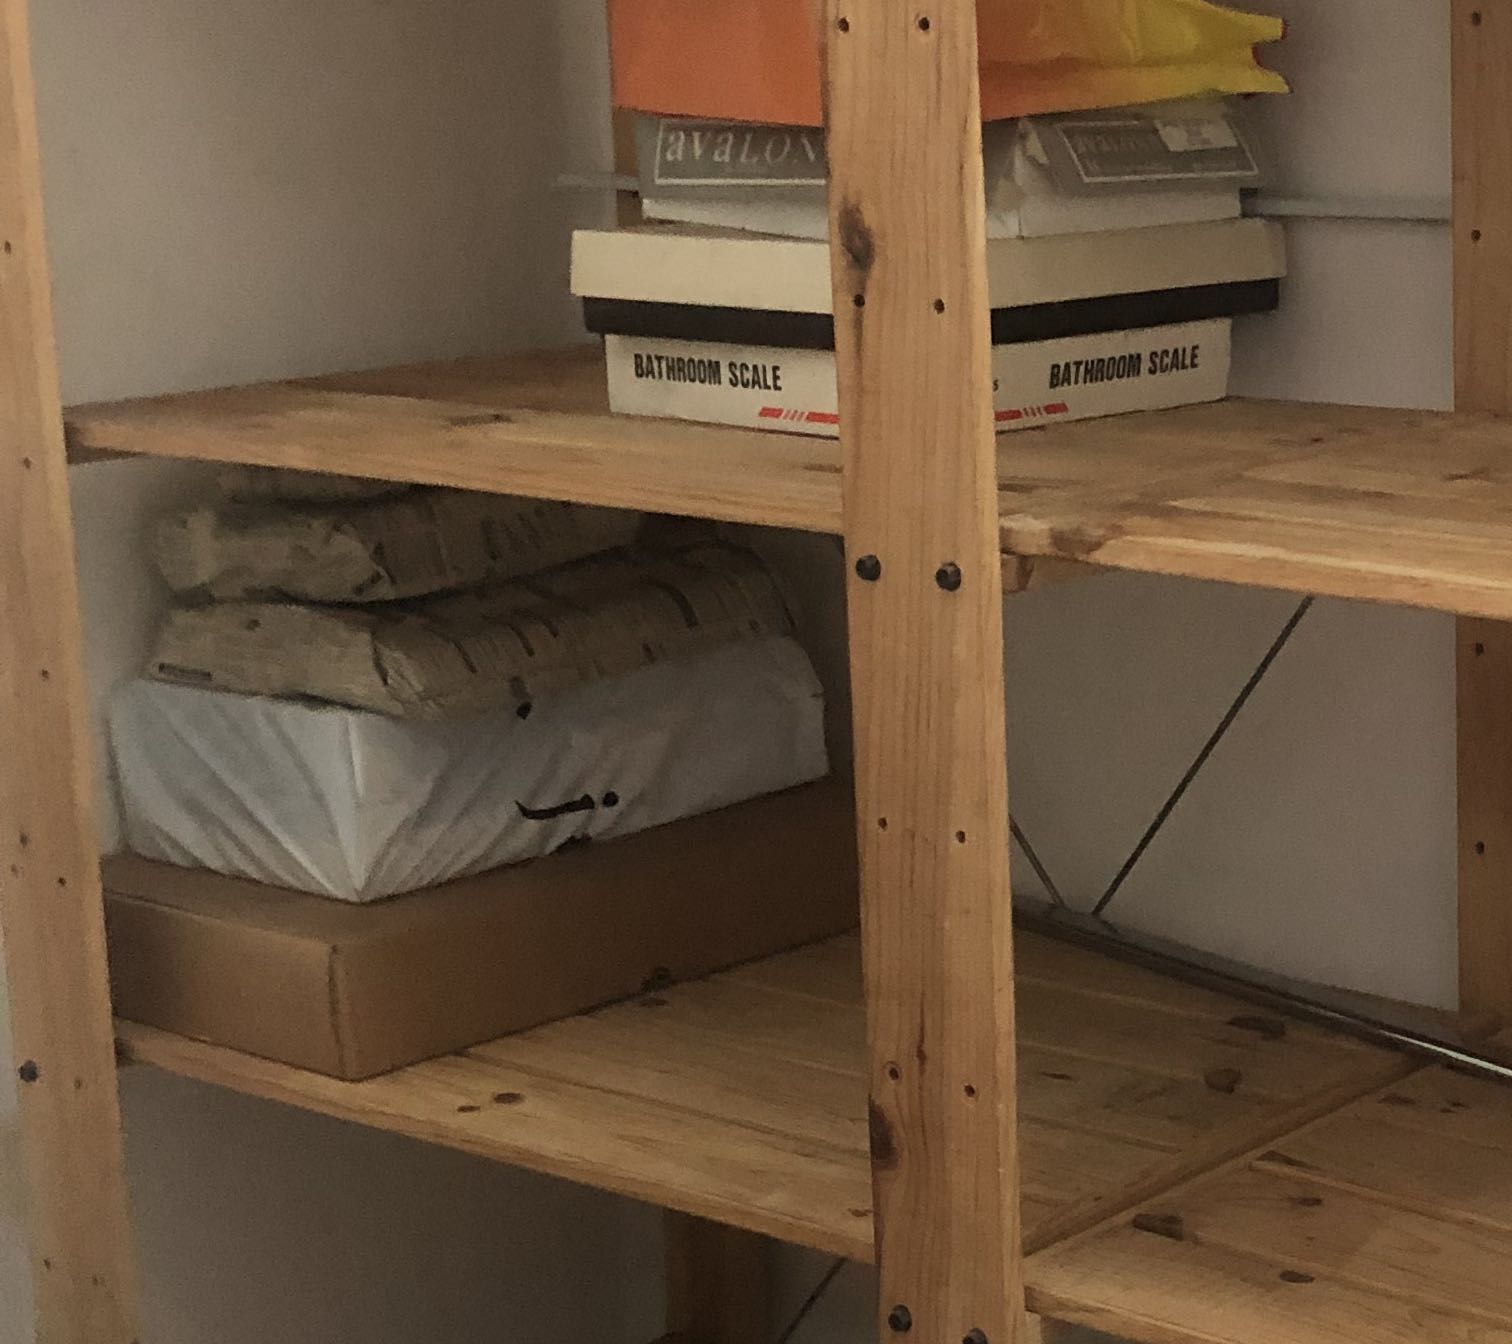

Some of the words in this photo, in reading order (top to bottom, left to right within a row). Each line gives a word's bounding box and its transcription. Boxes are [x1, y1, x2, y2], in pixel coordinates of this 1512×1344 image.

[634, 353, 722, 386] BATHROOM
[728, 360, 782, 391] SCALE
[1049, 353, 1142, 389] BATHROOM
[1147, 345, 1200, 375] SCALE
